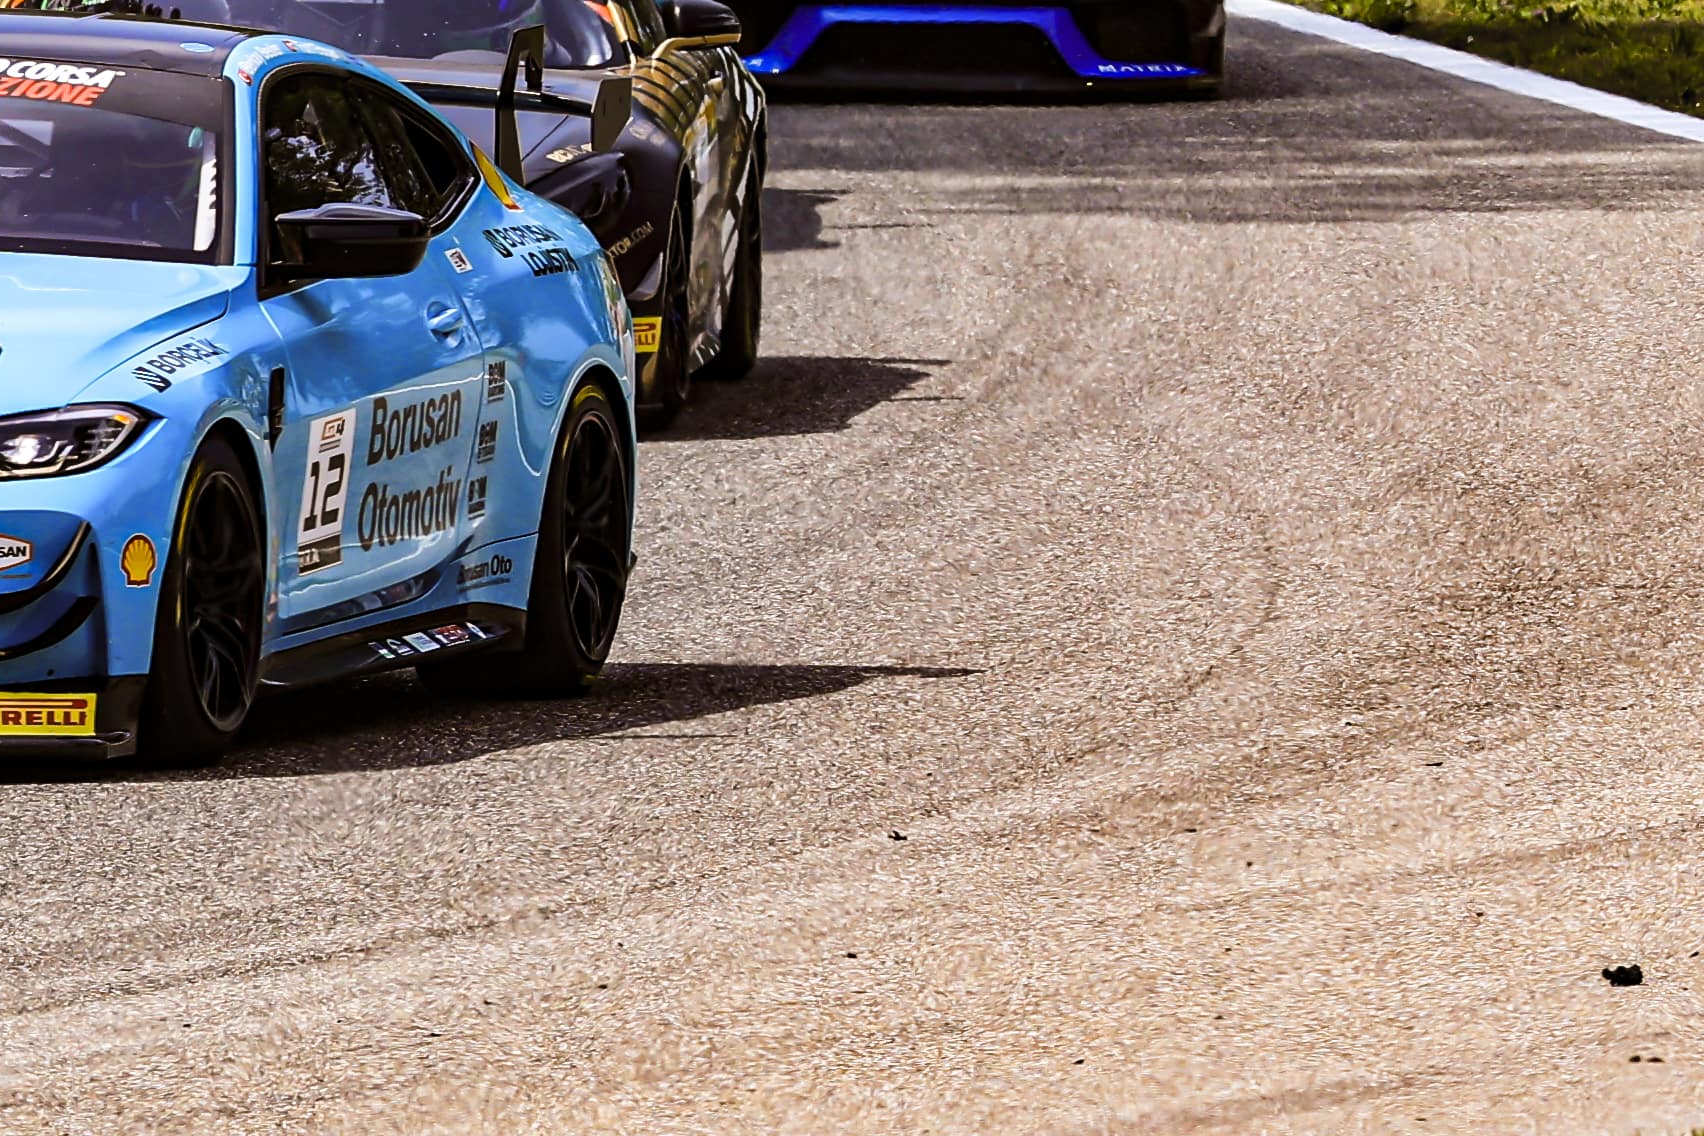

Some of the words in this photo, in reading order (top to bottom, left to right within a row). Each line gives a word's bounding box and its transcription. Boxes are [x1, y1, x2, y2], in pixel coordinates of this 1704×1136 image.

[7, 61, 116, 88] CORSA
[367, 388, 462, 465] Borusan
[303, 453, 346, 532] 12
[358, 465, 462, 552] Otomotiv
[490, 554, 513, 576] Oto
